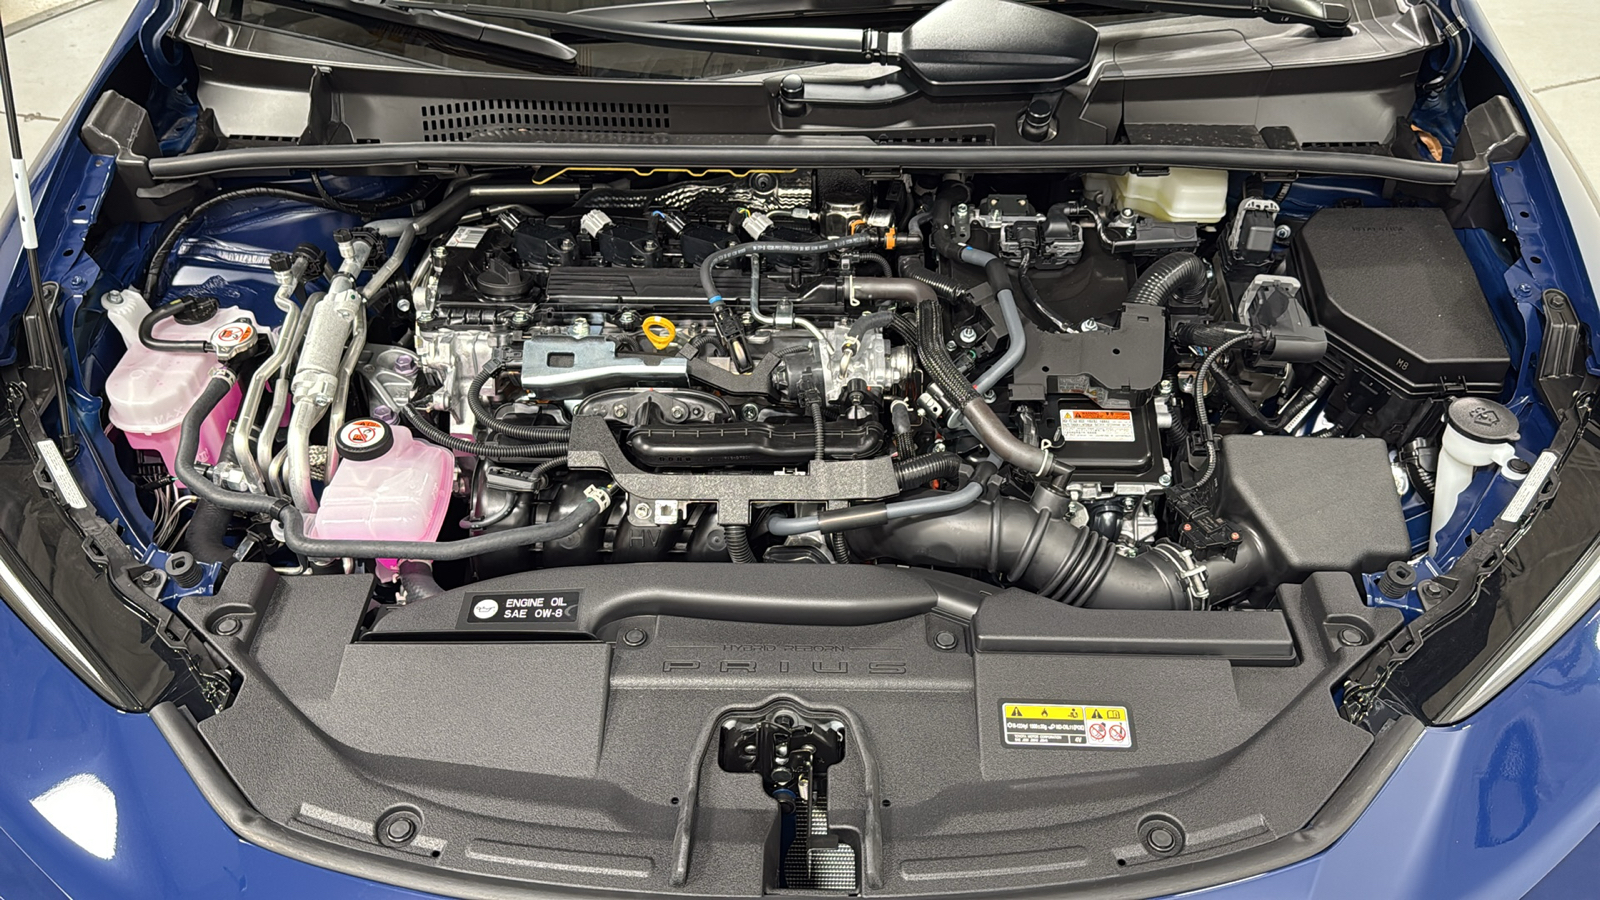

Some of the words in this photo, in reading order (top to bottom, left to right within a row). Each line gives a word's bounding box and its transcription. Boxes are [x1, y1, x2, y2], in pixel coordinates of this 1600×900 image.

[629, 528, 662, 548] HV
[505, 597, 545, 608] ENGINE
[550, 597, 567, 607] OIL
[503, 609, 528, 619] SAE
[534, 608, 563, 618] 0W-8
[722, 644, 777, 652] HYBRID
[784, 644, 845, 652] REBORN
[662, 660, 907, 675] PRIUS
